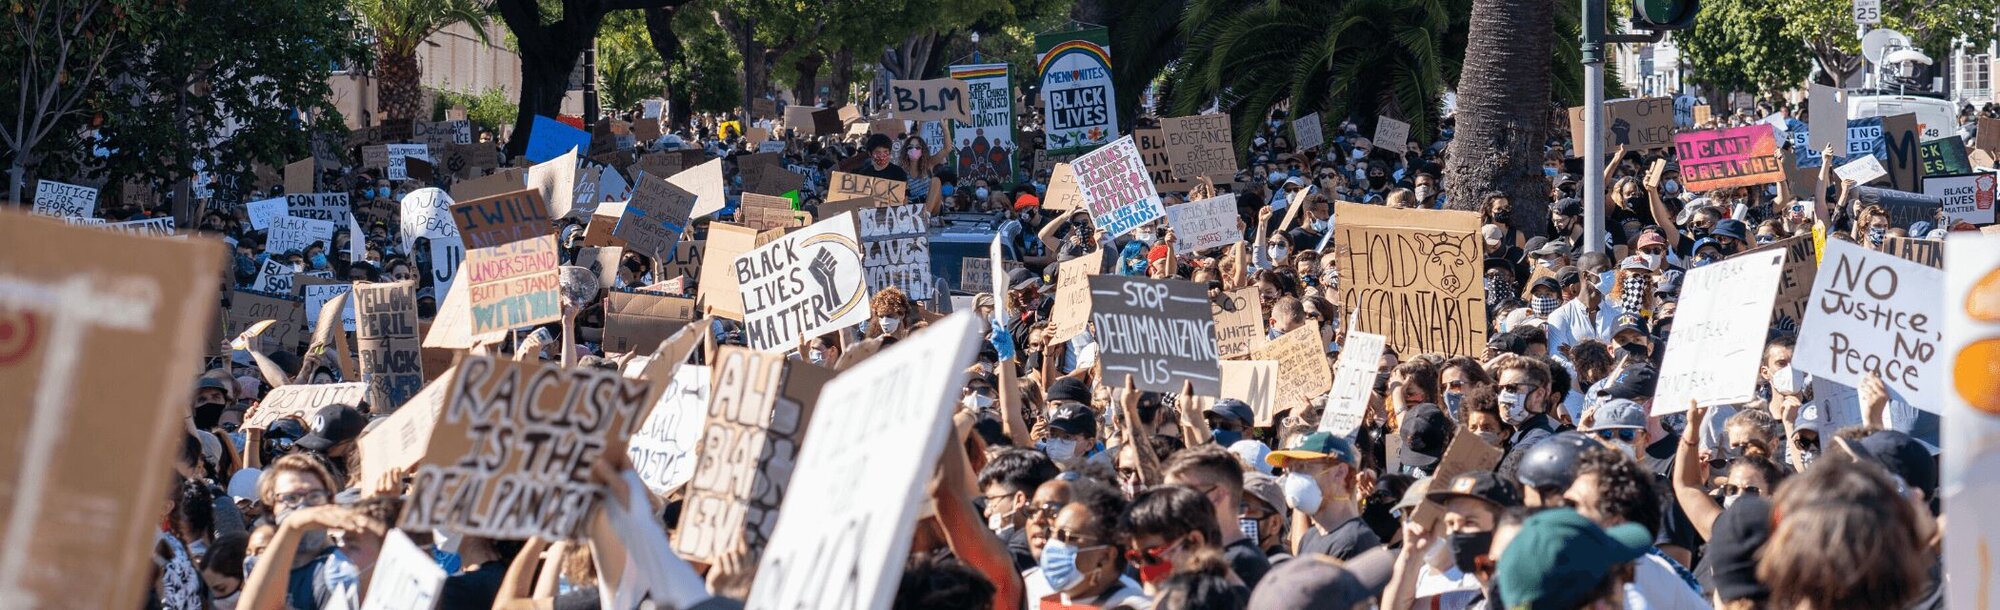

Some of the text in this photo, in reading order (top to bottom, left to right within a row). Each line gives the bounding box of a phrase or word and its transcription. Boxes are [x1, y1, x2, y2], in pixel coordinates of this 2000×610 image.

[1857, 8, 1877, 19] 25
[893, 86, 966, 115] BLM
[1052, 87, 1105, 110] BLACK
[1637, 99, 1670, 117] OFF
[1053, 106, 1106, 128] LIVES
[1181, 116, 1224, 130] RESPECT
[1170, 129, 1231, 145] EXISTANCE
[1682, 138, 1750, 159] I CANT
[1074, 145, 1122, 177] LESBIANS
[1174, 158, 1235, 176] RESISTANCE
[1187, 148, 1227, 161] EXPECT
[1083, 154, 1132, 188] AGAINST
[1685, 157, 1777, 181] BREATHE
[40, 181, 96, 201] JUSTICE
[56, 194, 74, 206] FOR
[287, 194, 347, 207] CON MAS
[841, 174, 900, 203] BLACK
[1088, 179, 1151, 218] BRUTALITY
[1090, 173, 1129, 201] POLICE
[1944, 186, 1974, 196] BLACK
[1944, 195, 1975, 206] LIVES
[36, 197, 84, 217] GEORGE
[288, 209, 346, 221] FUERZA Y
[456, 205, 478, 230] I
[476, 194, 547, 225] WILL
[858, 203, 926, 237] BLACK
[1096, 199, 1150, 228] ALL COPS ARE
[1105, 204, 1160, 237] BASTARDS!
[273, 216, 308, 231] BLACK
[273, 230, 306, 243] LIVES
[270, 239, 307, 250] MATTE
[862, 236, 929, 267] LIVES
[469, 251, 556, 282] UNDERSTAND
[735, 237, 799, 284] BLACK
[1346, 230, 1418, 288] HOLD
[471, 273, 559, 303] BUT I STAND
[863, 263, 933, 300] MATTER
[1831, 253, 1898, 300] NO
[308, 286, 325, 297] LA
[357, 288, 414, 313] YELLOW
[741, 267, 804, 315] LIVES
[1123, 281, 1169, 312] STOP
[360, 313, 413, 337] PERIL
[472, 294, 529, 334] WITH
[747, 294, 830, 350] MATTER
[1344, 288, 1482, 360] ACCOUNTABLE
[380, 334, 390, 352] 4
[1094, 312, 1220, 368] DEHUMANIZING
[361, 350, 421, 374] BLACK
[1141, 360, 1170, 384] US
[1830, 332, 1919, 392] Peace
[446, 355, 652, 441] RACISM
[457, 422, 607, 482] IS THE
[404, 464, 486, 533] REAL
